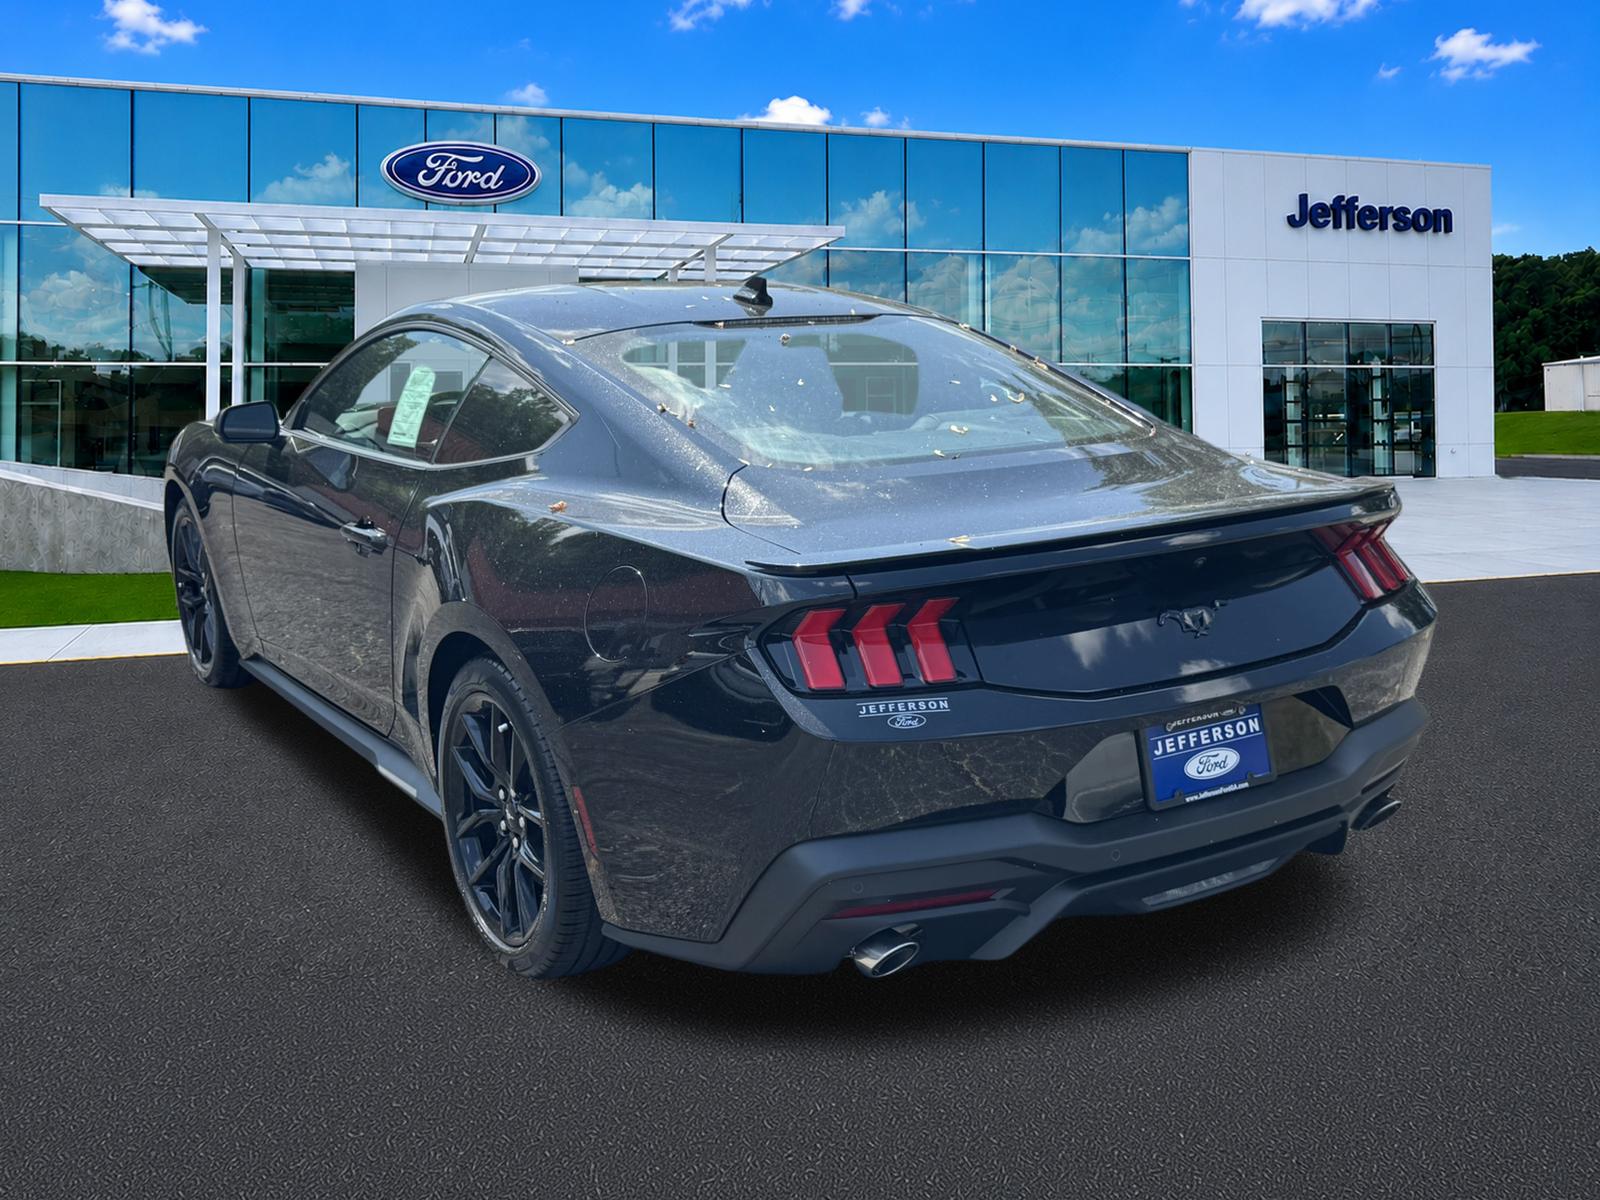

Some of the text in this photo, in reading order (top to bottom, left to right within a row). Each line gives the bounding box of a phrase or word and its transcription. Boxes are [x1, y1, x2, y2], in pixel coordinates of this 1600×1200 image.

[417, 152, 506, 190] Ford
[1286, 193, 1453, 234] Jefferson
[859, 700, 949, 715] JEFFERSON
[894, 715, 919, 727] Ford
[1153, 717, 1260, 756] JEFFERSON
[1196, 753, 1229, 775] Ford
